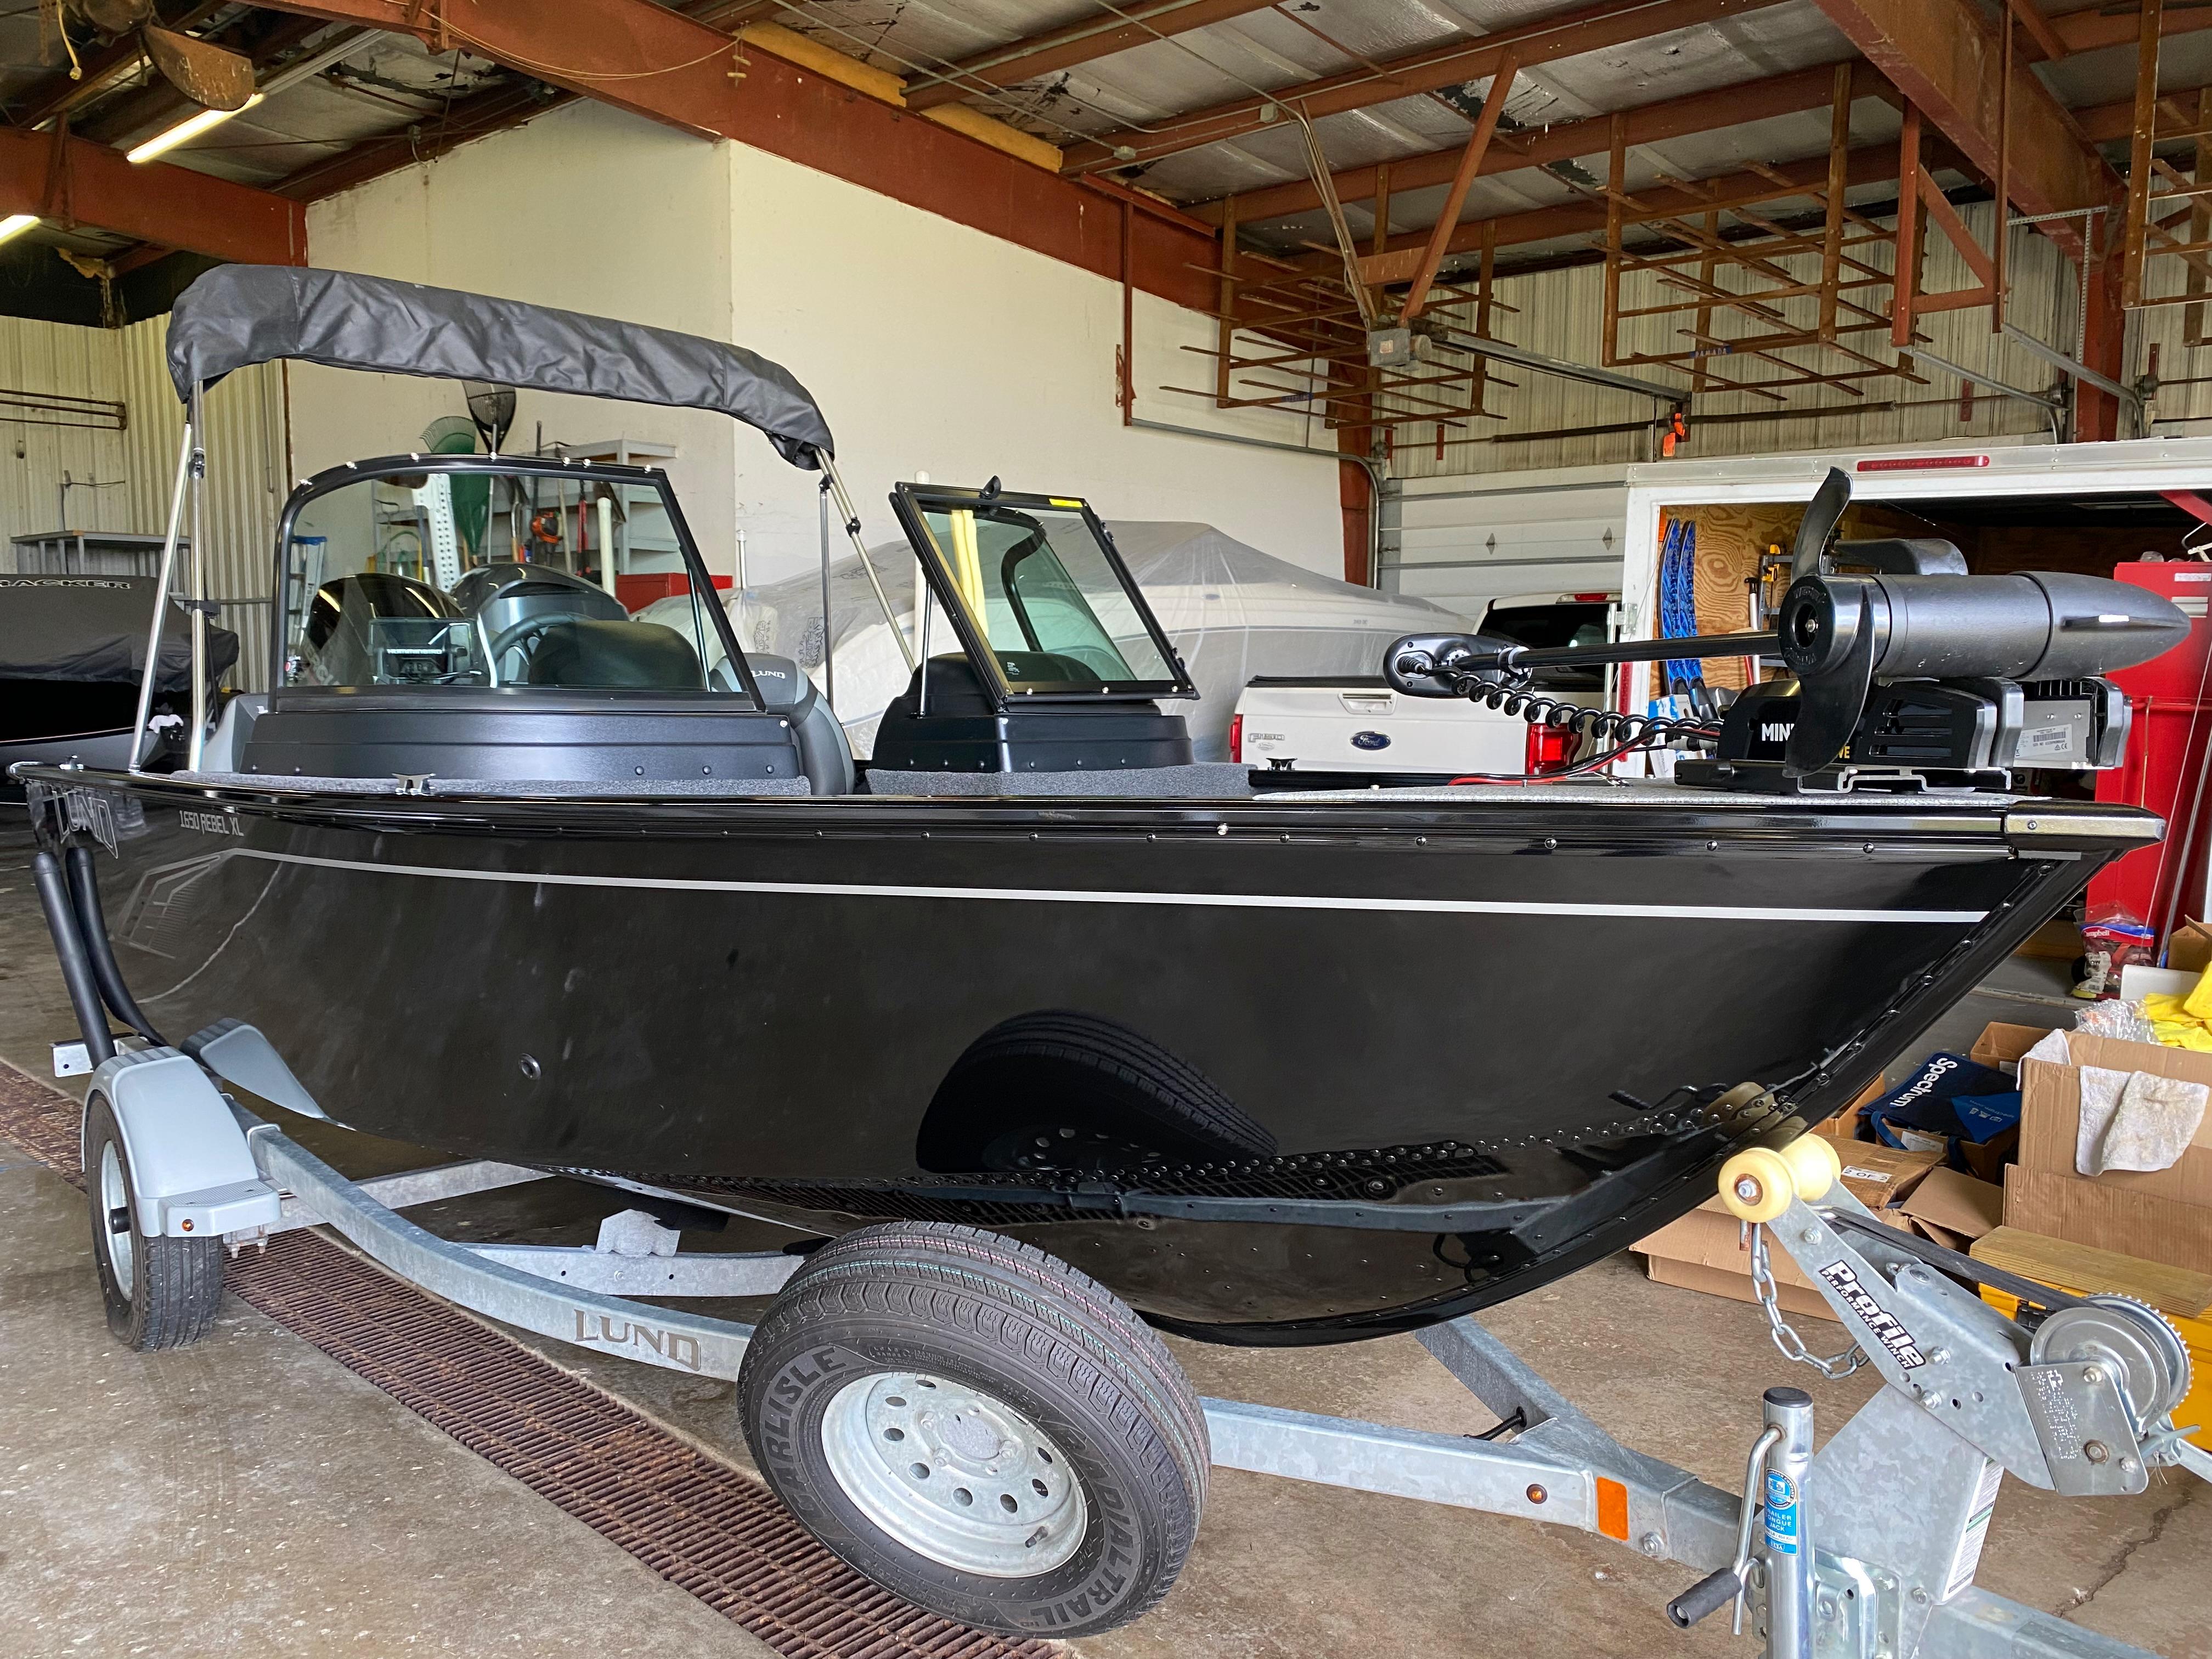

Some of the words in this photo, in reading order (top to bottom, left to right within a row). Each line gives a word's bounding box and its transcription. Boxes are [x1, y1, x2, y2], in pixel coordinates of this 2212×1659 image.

[751, 670, 786, 679] LUND
[1357, 735, 1381, 746] Ford
[1762, 723, 1795, 741] MIN
[52, 789, 119, 859] LUND
[179, 810, 200, 830] 1650
[200, 812, 229, 834] REBEL
[229, 816, 245, 837] XL
[1889, 1057, 1958, 1108] Spectrum
[574, 1309, 701, 1372] LUND
[1821, 1270, 1882, 1334] PERFORMANCE
[1881, 1335, 1911, 1368] WINCH
[1825, 1260, 1926, 1367] Profile
[765, 1347, 847, 1520] CARLISLE
[1769, 1522, 1786, 1532] JACK
[1030, 1567, 1127, 1626] TRAIL
